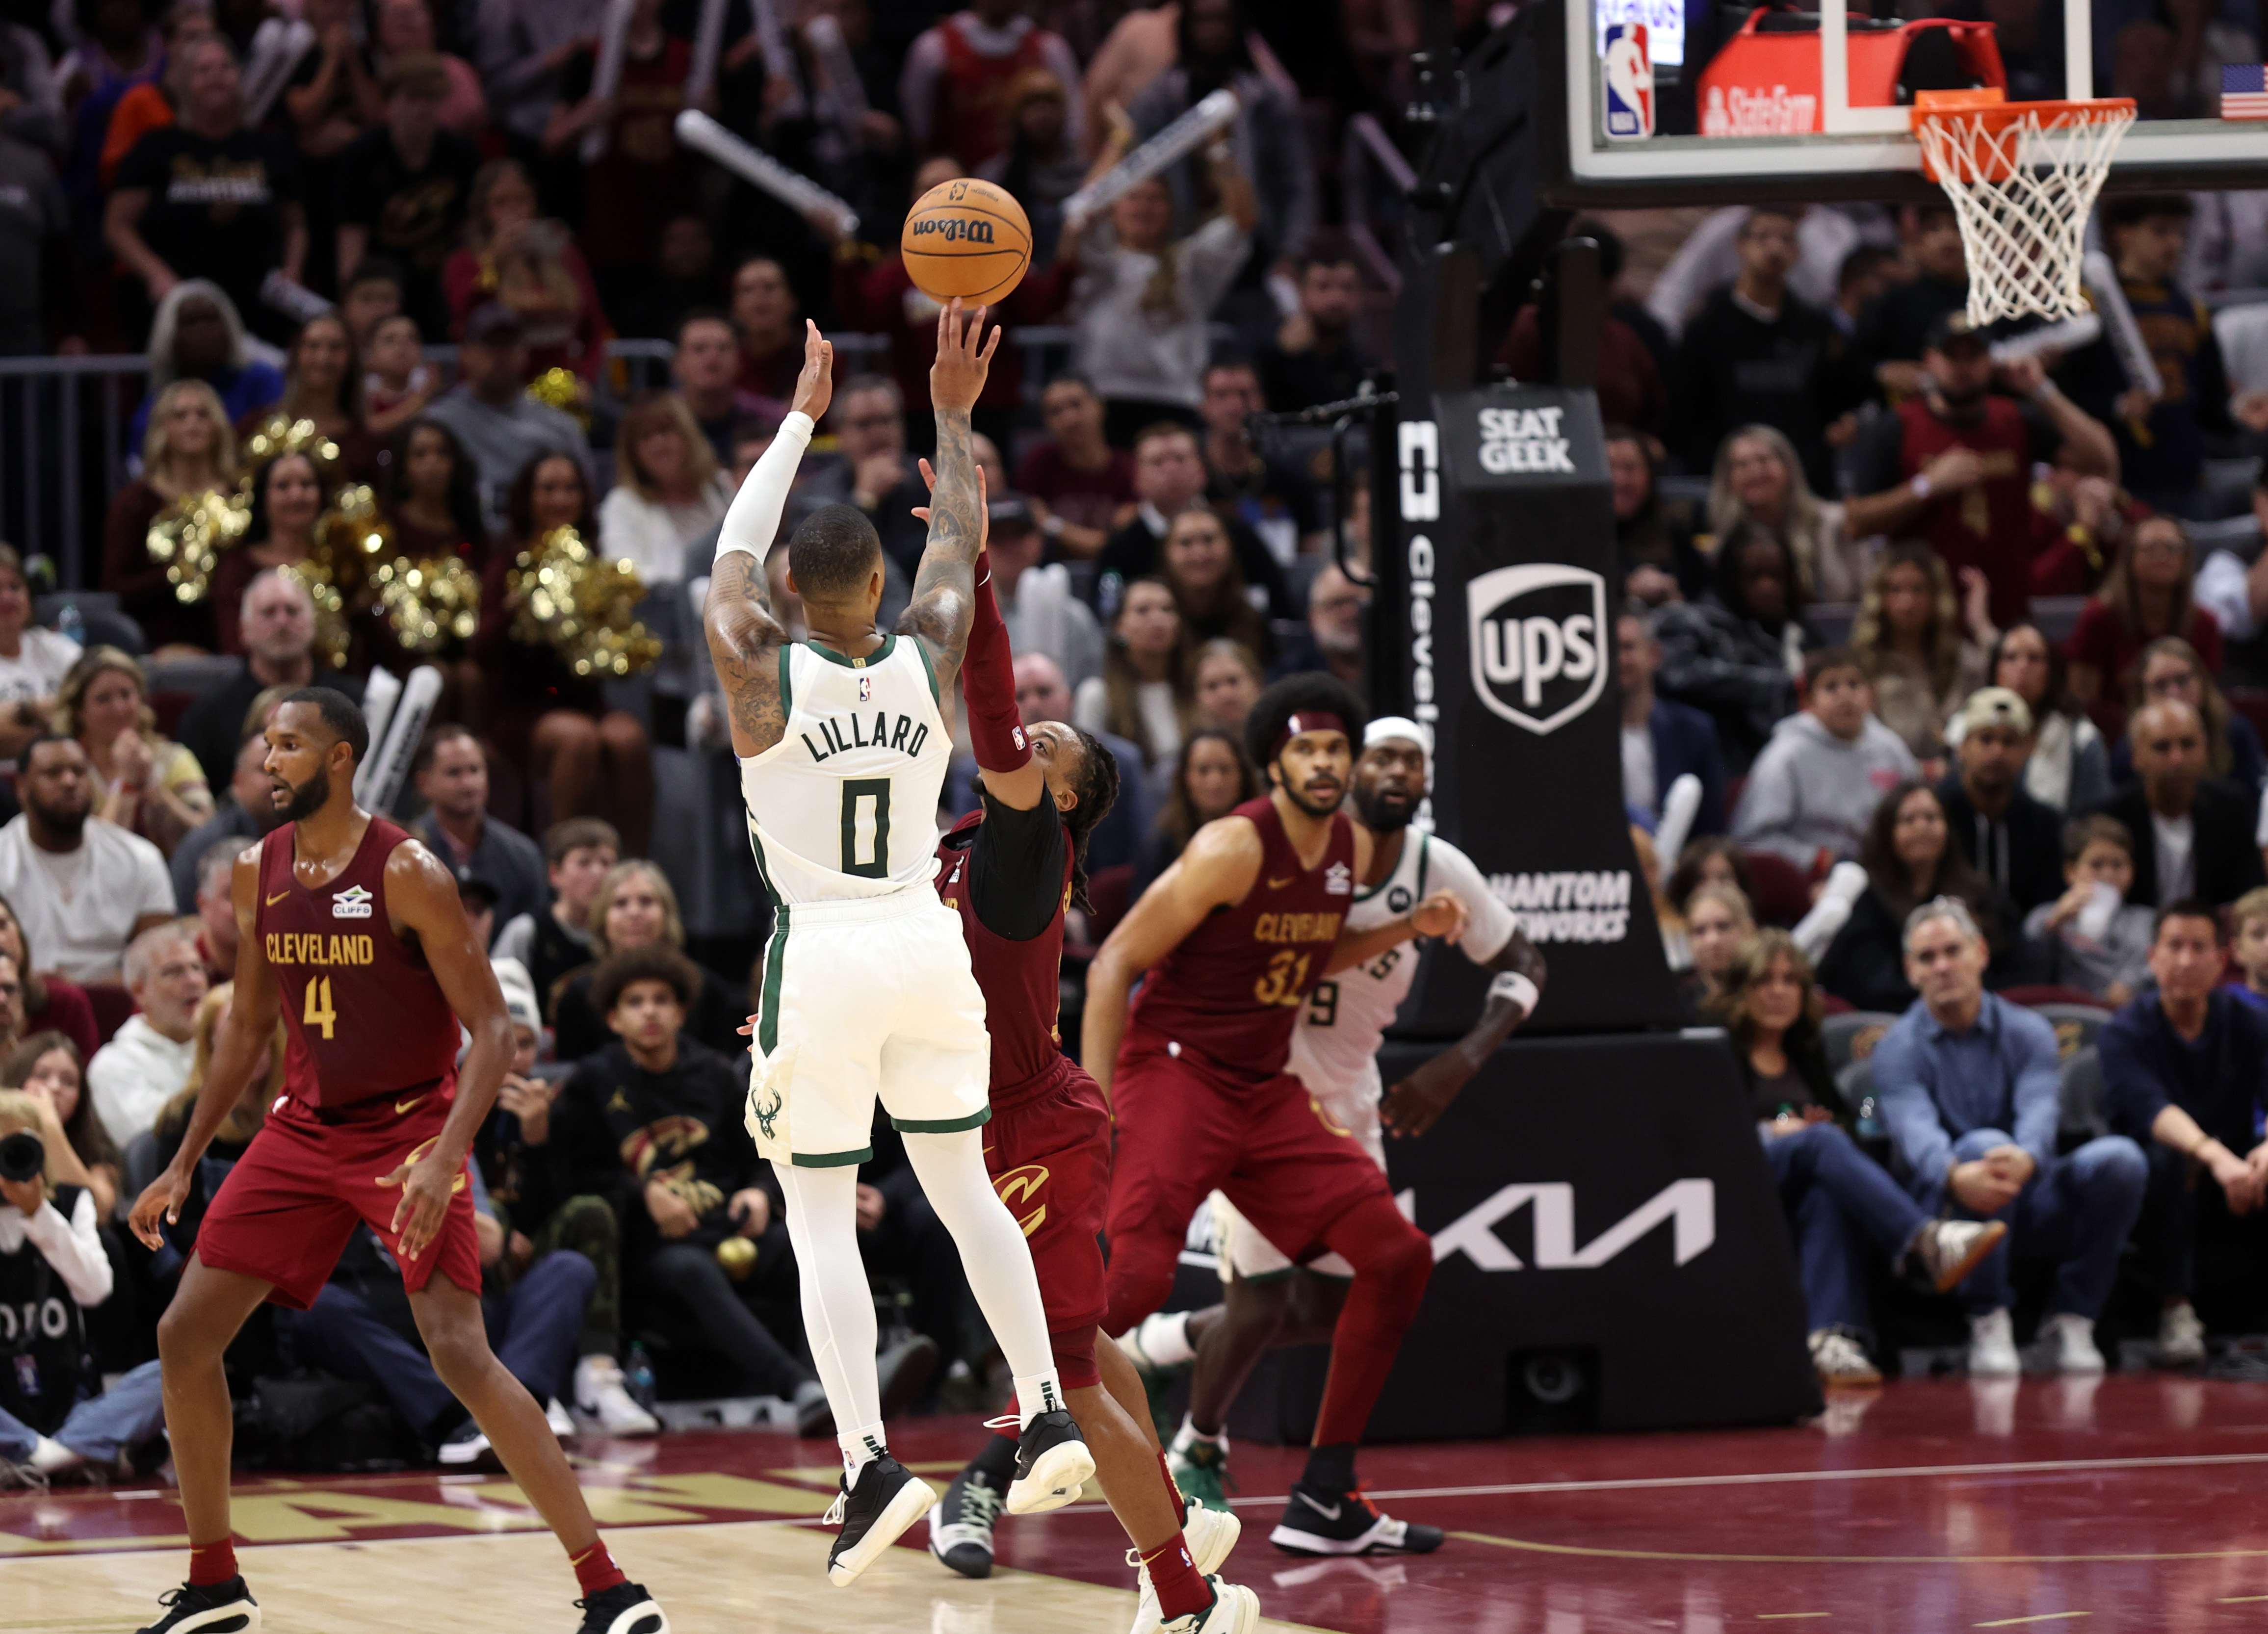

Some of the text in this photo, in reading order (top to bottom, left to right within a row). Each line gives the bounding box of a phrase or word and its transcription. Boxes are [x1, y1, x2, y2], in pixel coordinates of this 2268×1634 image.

[913, 218, 995, 244] Wilson
[1477, 407, 1564, 440] SEAT
[1477, 438, 1576, 474] GEEK
[801, 712, 928, 763] LILLARD
[838, 775, 892, 880] 0
[1486, 870, 1632, 908] HANTOM
[266, 933, 374, 965] CLEVELAND
[1254, 950, 1312, 1006] 31
[303, 975, 337, 1039] 4
[1308, 981, 1339, 1027] 9
